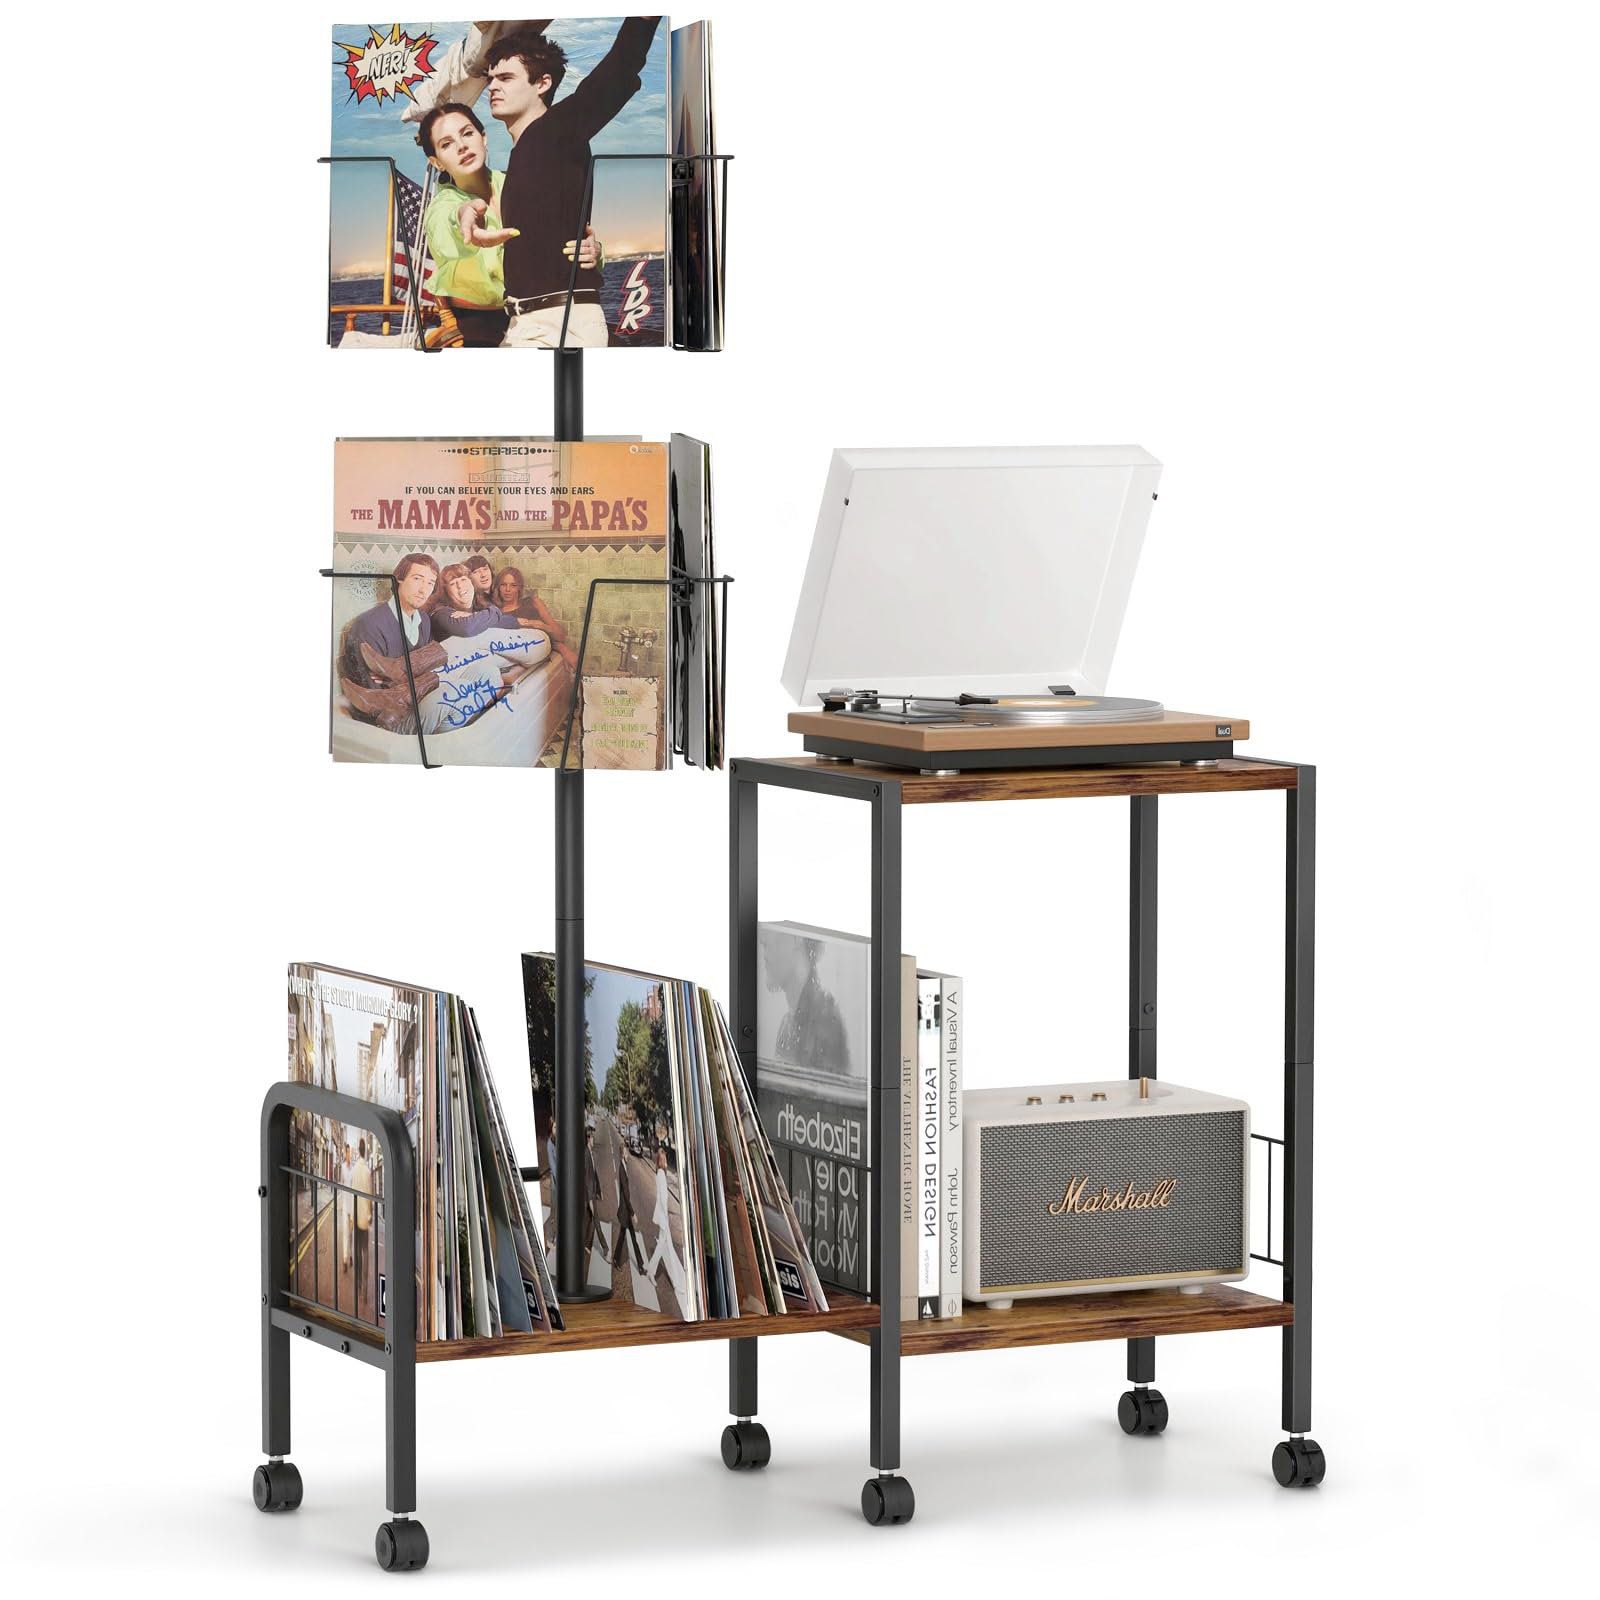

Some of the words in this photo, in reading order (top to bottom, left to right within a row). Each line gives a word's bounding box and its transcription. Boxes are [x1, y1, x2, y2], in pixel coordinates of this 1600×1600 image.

[368, 48, 411, 80] NFR!
[619, 260, 652, 332] LDR
[469, 446, 531, 456] STEREO
[405, 486, 413, 495] IF
[416, 486, 434, 495] YOU
[437, 486, 455, 495] CAN
[458, 486, 494, 495] BELIEVE
[497, 486, 521, 495] YOUR
[524, 486, 547, 495] EYES
[550, 486, 568, 495] AND
[571, 486, 595, 495] EARS
[351, 509, 373, 521] THE
[377, 497, 492, 530] MAMA'S
[497, 510, 520, 521] AND
[524, 510, 547, 521] THE
[552, 497, 649, 531] PAPA'S
[390, 998, 411, 1022] GLORY
[1049, 1175, 1177, 1215] Marshall
[779, 1267, 800, 1289] sis
